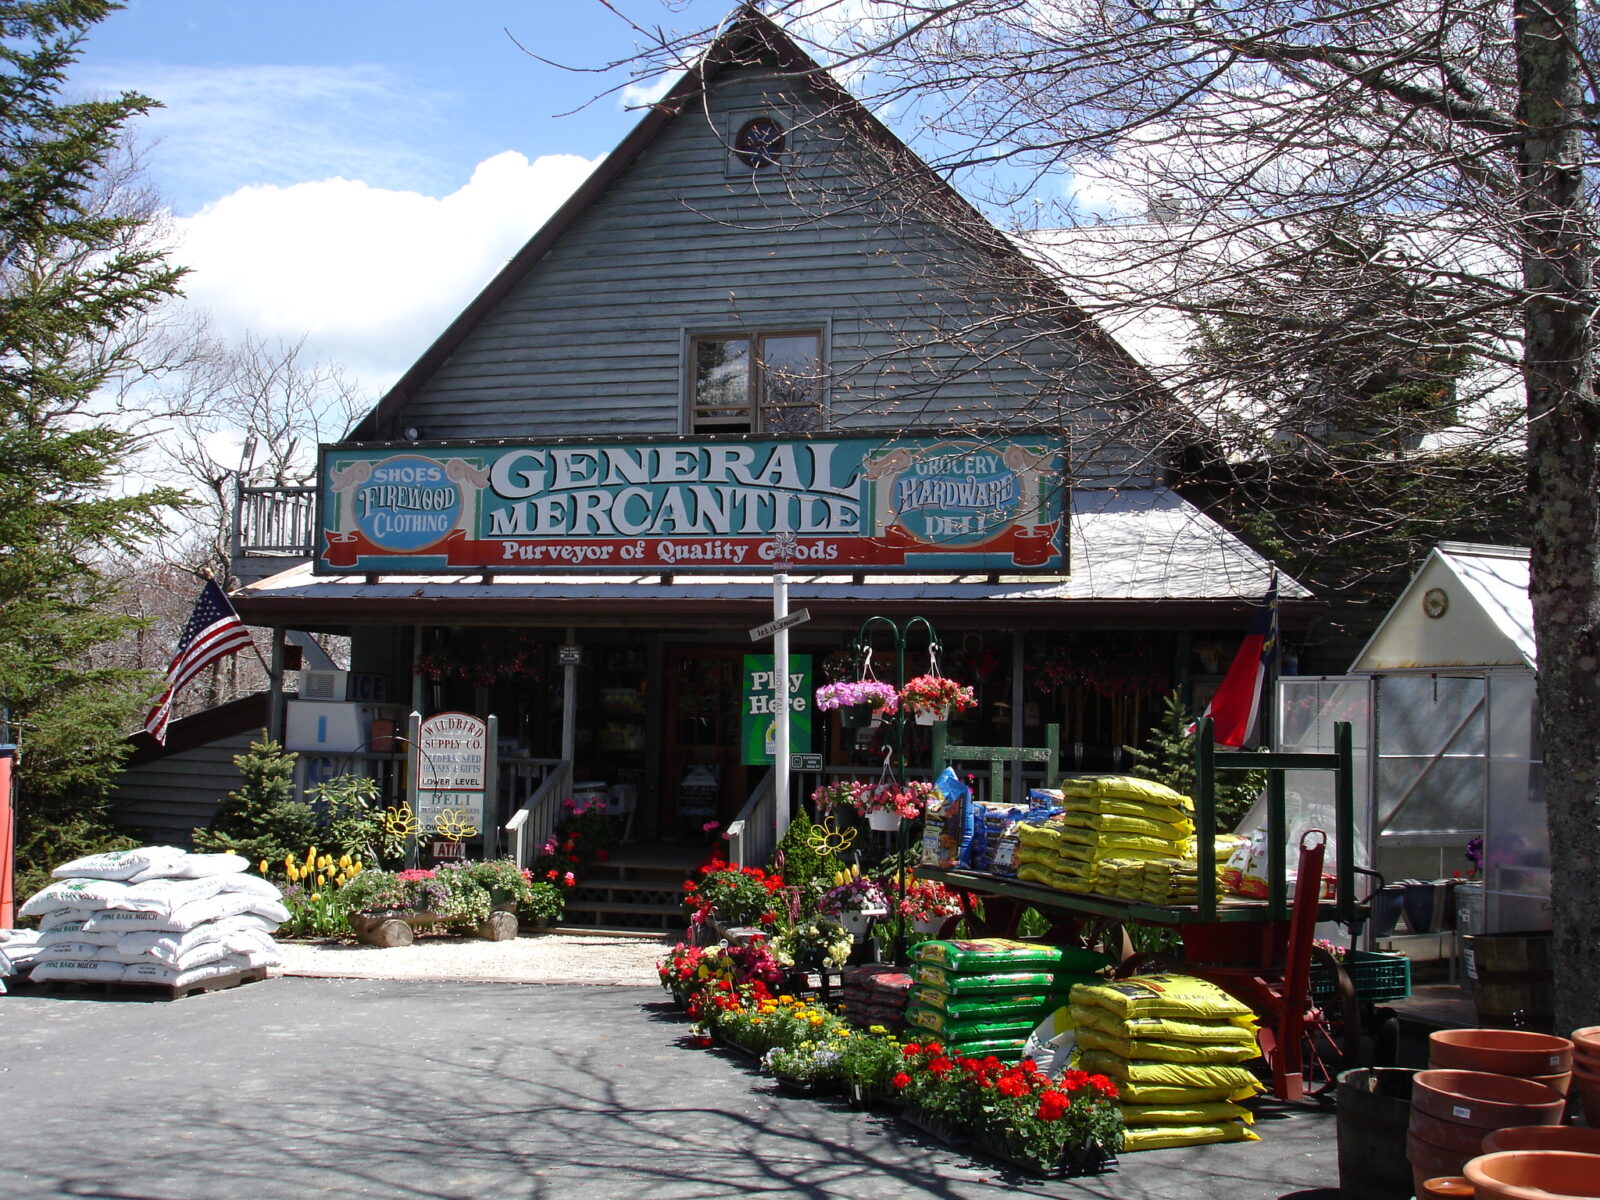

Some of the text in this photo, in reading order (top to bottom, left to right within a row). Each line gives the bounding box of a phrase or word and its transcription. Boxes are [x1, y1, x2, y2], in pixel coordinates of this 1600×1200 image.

[374, 467, 442, 482] SHOES
[490, 443, 860, 499] GENERAL
[915, 454, 999, 475] GROCERY
[358, 483, 456, 518] FIREWOOD
[899, 475, 1014, 513] HARDWARE
[489, 485, 861, 536] MERCANTILE
[373, 512, 448, 539] CLOTHING
[924, 515, 986, 537] DELI
[502, 540, 839, 564] Purveyor of Quality Gods
[352, 675, 385, 700] ICE
[751, 671, 804, 693] Ply
[423, 718, 484, 738] WILDBIRD
[425, 739, 483, 750] SUPPLY CO.
[460, 764, 481, 774] GIFTS
[461, 754, 481, 763] SEED
[422, 778, 480, 786] LOWER LEVEL
[431, 794, 471, 806] DELI
[101, 913, 158, 921] PINE BARK MULCH
[76, 962, 99, 970] MULCH
